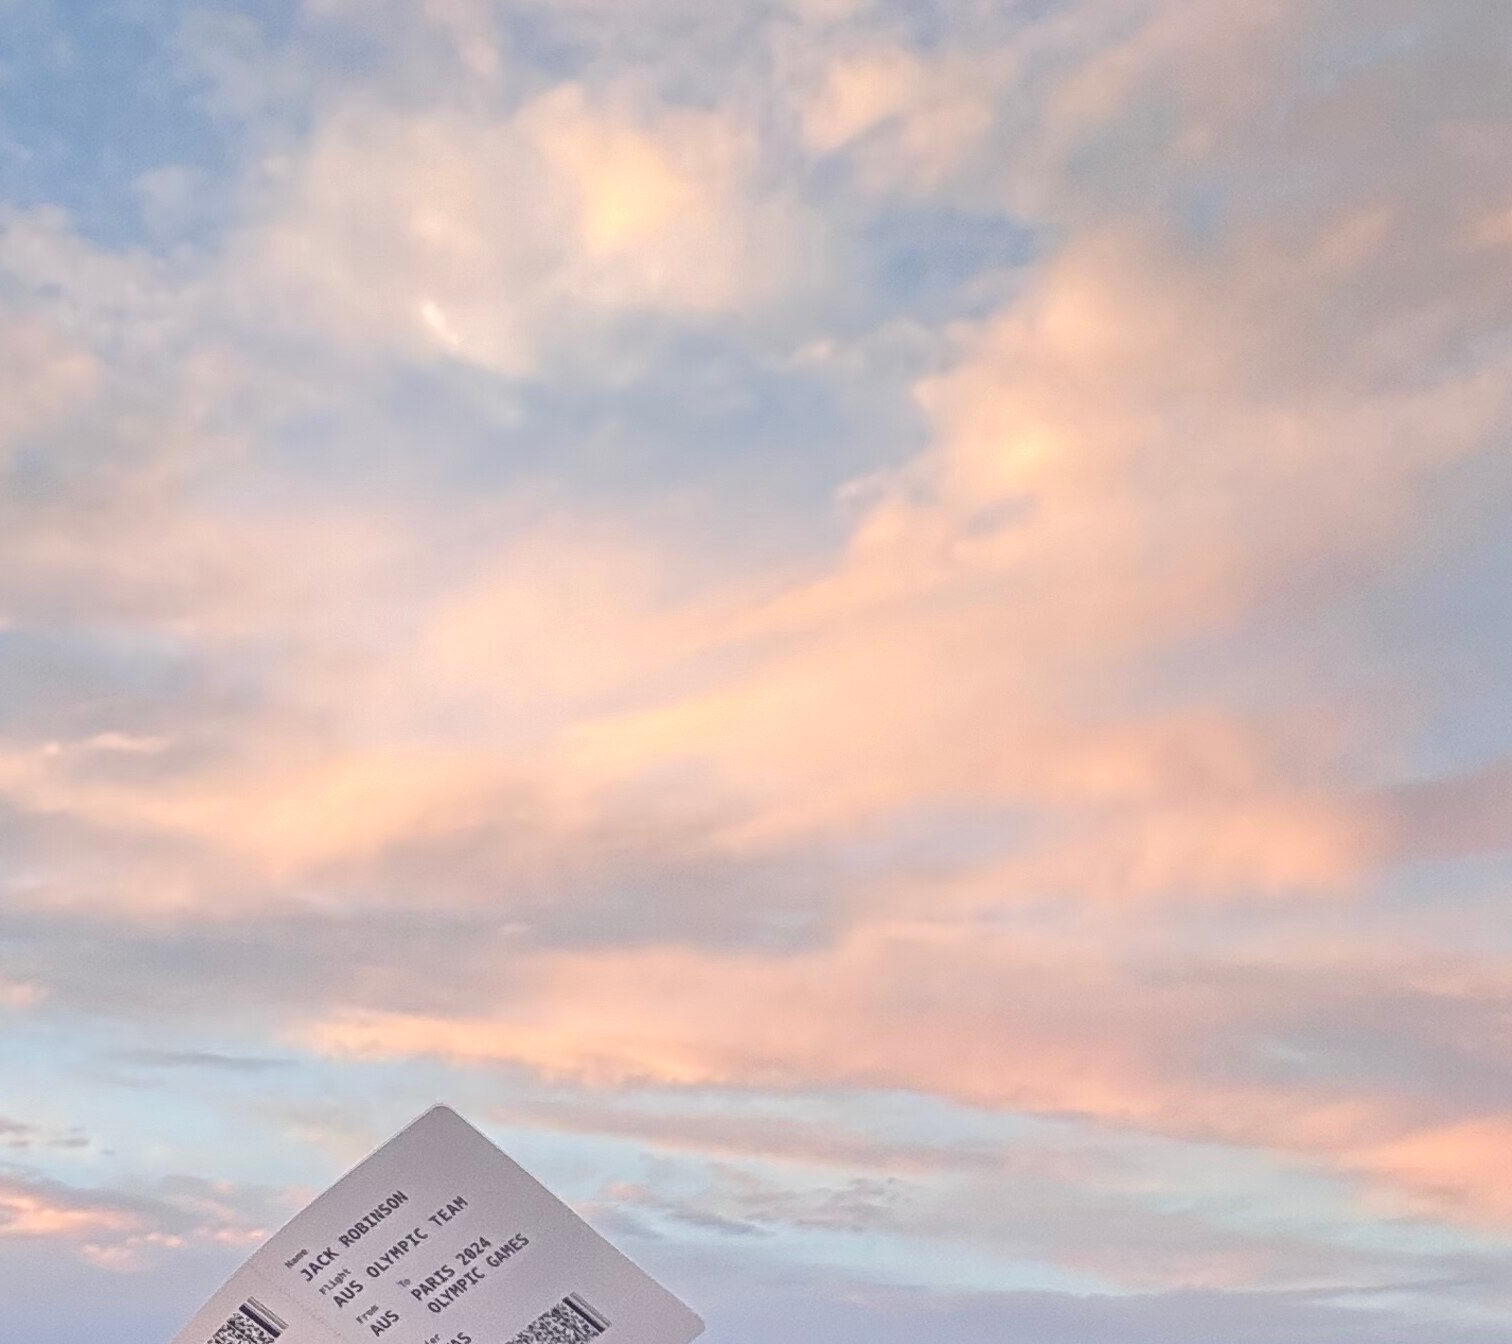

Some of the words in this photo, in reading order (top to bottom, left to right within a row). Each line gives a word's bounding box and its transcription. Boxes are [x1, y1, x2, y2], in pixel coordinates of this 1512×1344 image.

[299, 1246, 340, 1283] JACK
[338, 1189, 409, 1248] ROBINSON
[283, 1248, 309, 1270] Name
[332, 1279, 364, 1309] AUS
[365, 1227, 429, 1278] OLYMPIC
[427, 1195, 469, 1227] TEAM
[318, 1268, 352, 1296] Flight
[395, 1278, 411, 1288] To
[410, 1264, 456, 1302] PARIS
[454, 1236, 492, 1267] 2024
[427, 1266, 486, 1314] OLYMPIC
[485, 1232, 530, 1268] GAMES
[355, 1304, 380, 1325] From
[369, 1309, 400, 1338] AUS
